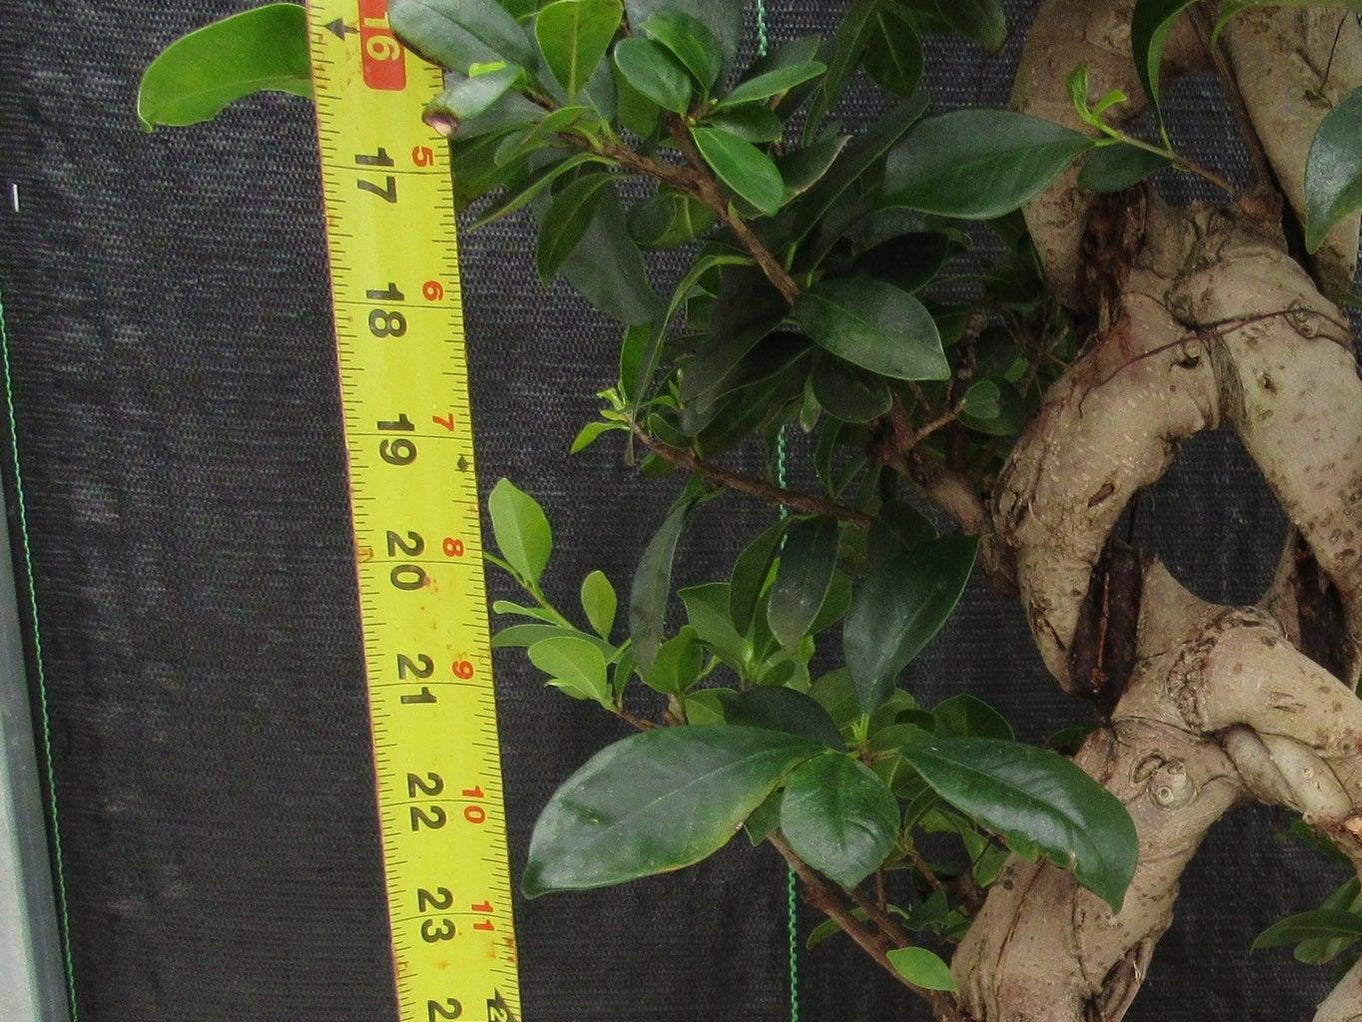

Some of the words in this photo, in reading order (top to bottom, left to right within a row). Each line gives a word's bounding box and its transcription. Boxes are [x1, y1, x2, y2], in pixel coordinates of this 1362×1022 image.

[364, 12, 400, 62] 16
[355, 147, 397, 203] 17
[412, 145, 435, 168] 5
[366, 282, 407, 338] 18
[422, 280, 444, 301] 6
[377, 413, 417, 466] 19
[432, 413, 455, 431] 7
[386, 530, 427, 591] 20
[442, 537, 464, 557] 8
[397, 653, 437, 704] 21
[452, 660, 474, 679] 9
[407, 772, 447, 831] 22
[462, 785, 486, 824] 10
[417, 887, 456, 943] 23
[471, 900, 495, 932] 11
